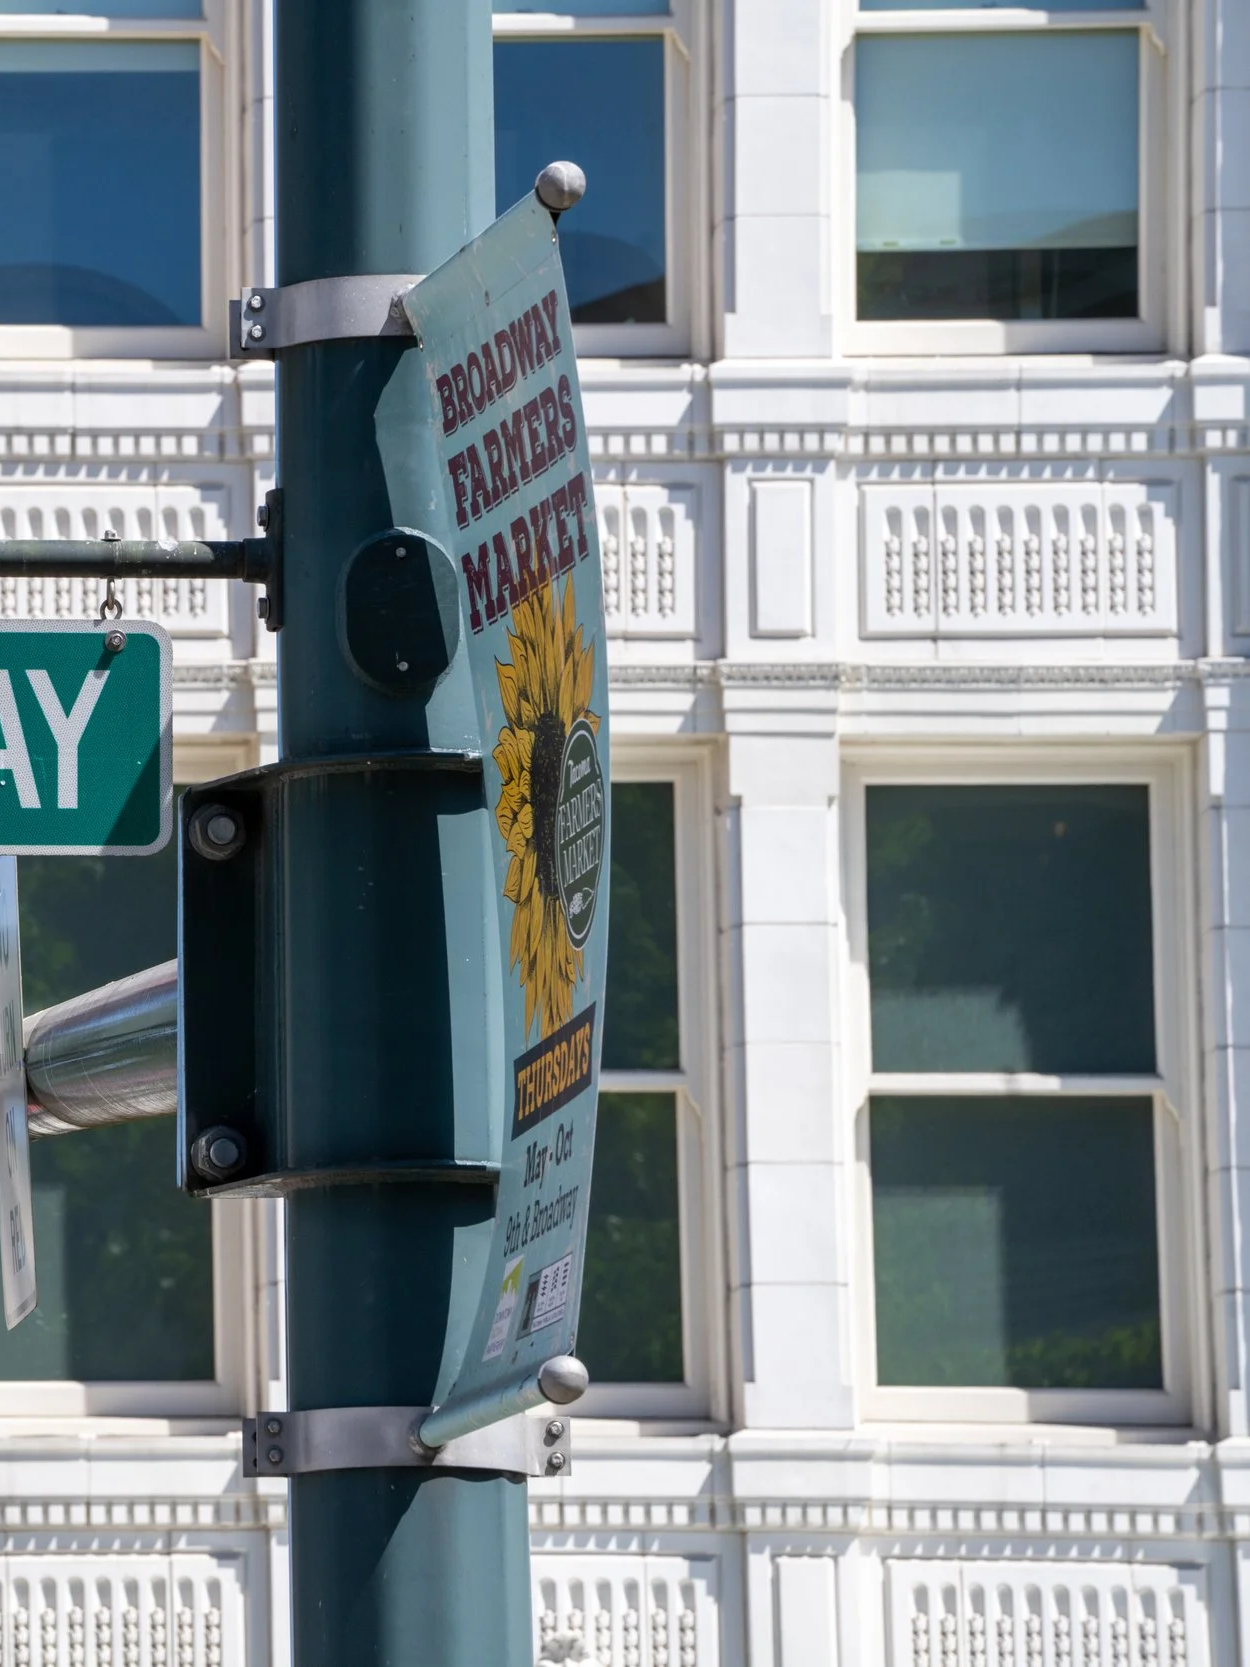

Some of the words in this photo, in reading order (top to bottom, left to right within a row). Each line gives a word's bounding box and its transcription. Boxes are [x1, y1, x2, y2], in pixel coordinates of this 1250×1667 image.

[436, 290, 562, 437] BROADWAY
[447, 374, 578, 530] FARMERS
[461, 471, 589, 635] MARKET
[567, 756, 591, 788] Tacoma
[559, 778, 601, 844] FARMERS
[562, 824, 601, 887] MARKET
[517, 1021, 591, 1121] THURSDAYS
[523, 1141, 548, 1189] May
[555, 1120, 574, 1166] Oct
[503, 1211, 521, 1257] 9th
[521, 1205, 531, 1248] &
[530, 1184, 579, 1243] Broadway
